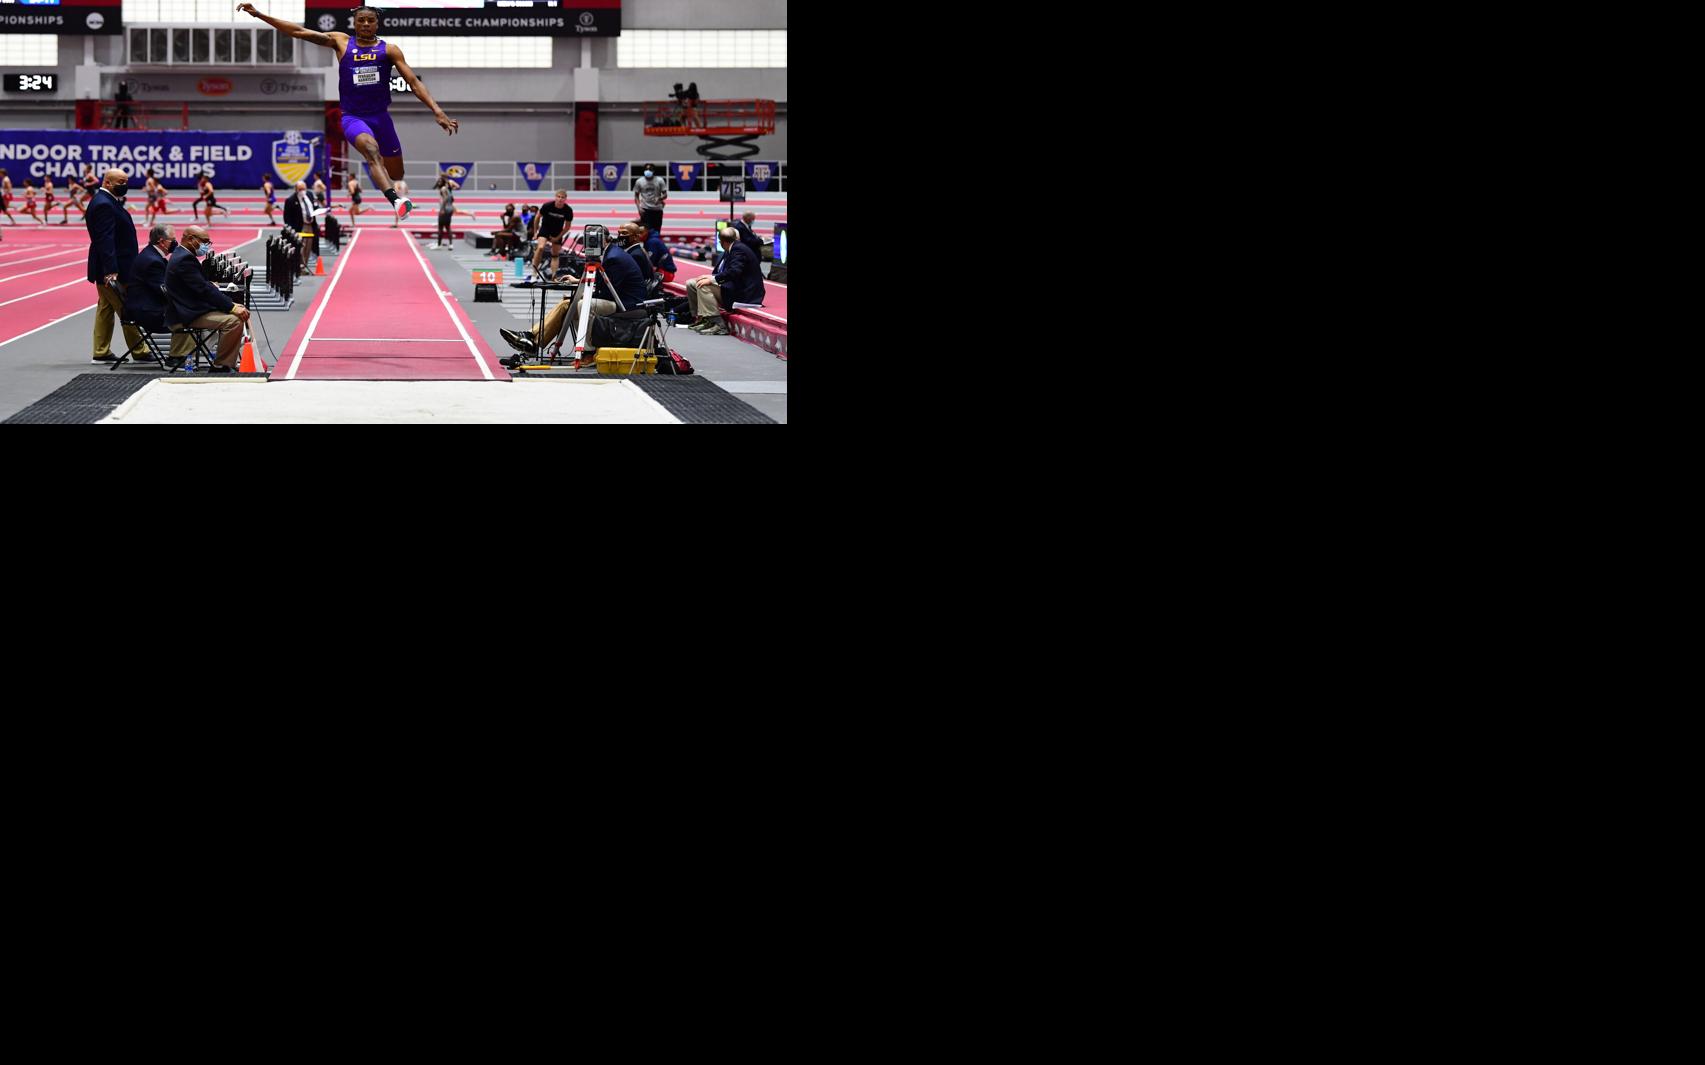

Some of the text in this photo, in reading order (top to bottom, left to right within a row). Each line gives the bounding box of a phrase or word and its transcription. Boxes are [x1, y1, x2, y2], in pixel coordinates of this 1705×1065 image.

[383, 18, 462, 27] CONFERENCE
[465, 18, 564, 27] CHAMPIONSHIPS
[353, 53, 377, 61] LSU
[19, 75, 52, 90] 3:24
[0, 144, 253, 161] NDOOR TRACK & FIELD
[480, 271, 496, 283] 10
